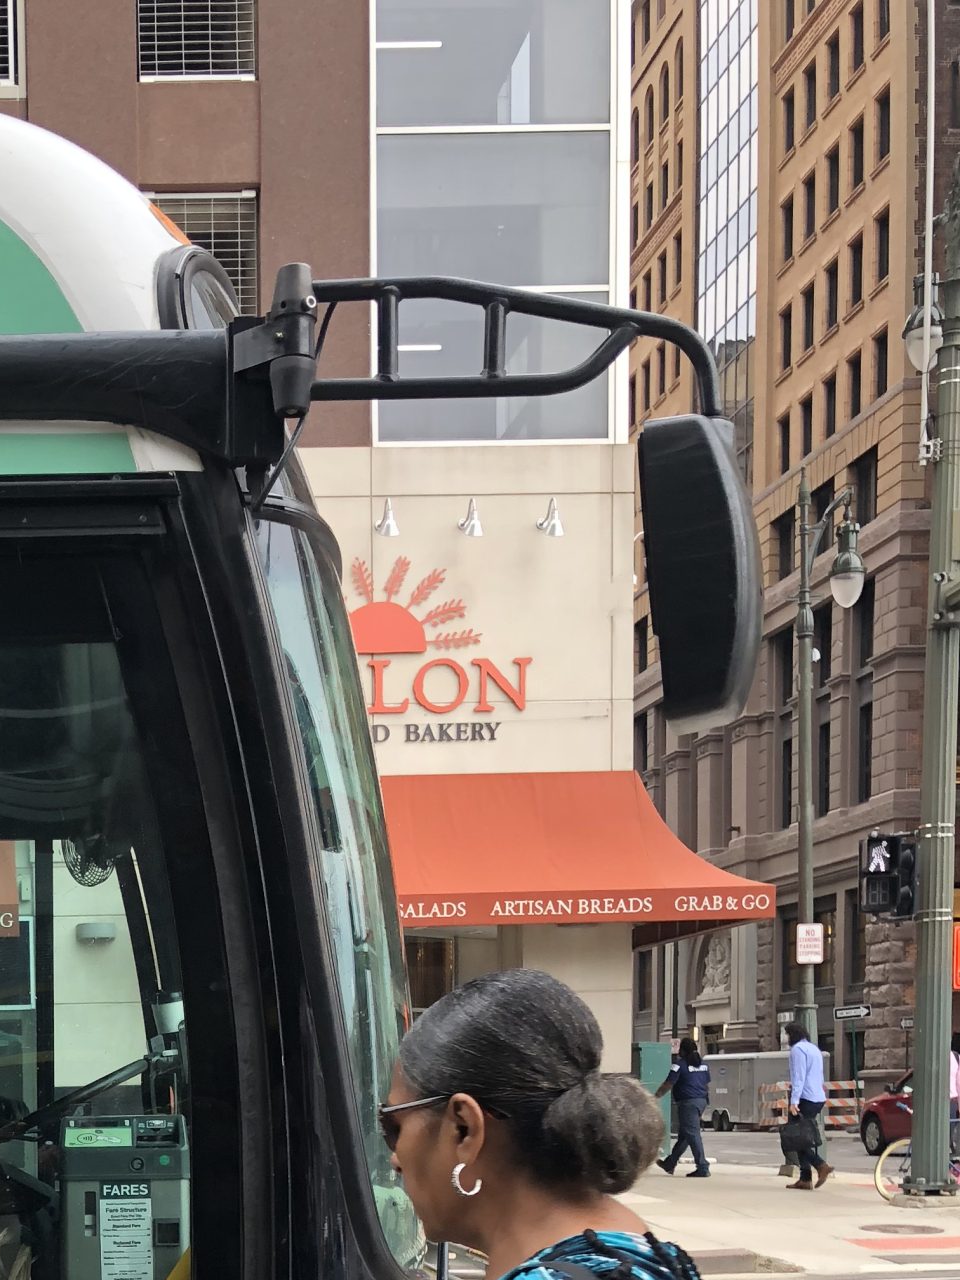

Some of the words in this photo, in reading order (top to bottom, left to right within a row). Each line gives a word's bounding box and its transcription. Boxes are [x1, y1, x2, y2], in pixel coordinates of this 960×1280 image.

[367, 656, 534, 714] LON
[404, 721, 503, 744] BAKERY
[490, 899, 573, 917] ARTISAN
[577, 897, 653, 916] BREADS
[674, 895, 724, 912] GRAB
[725, 896, 739, 911] &
[741, 894, 770, 911] GO
[102, 1184, 149, 1197] FARES
